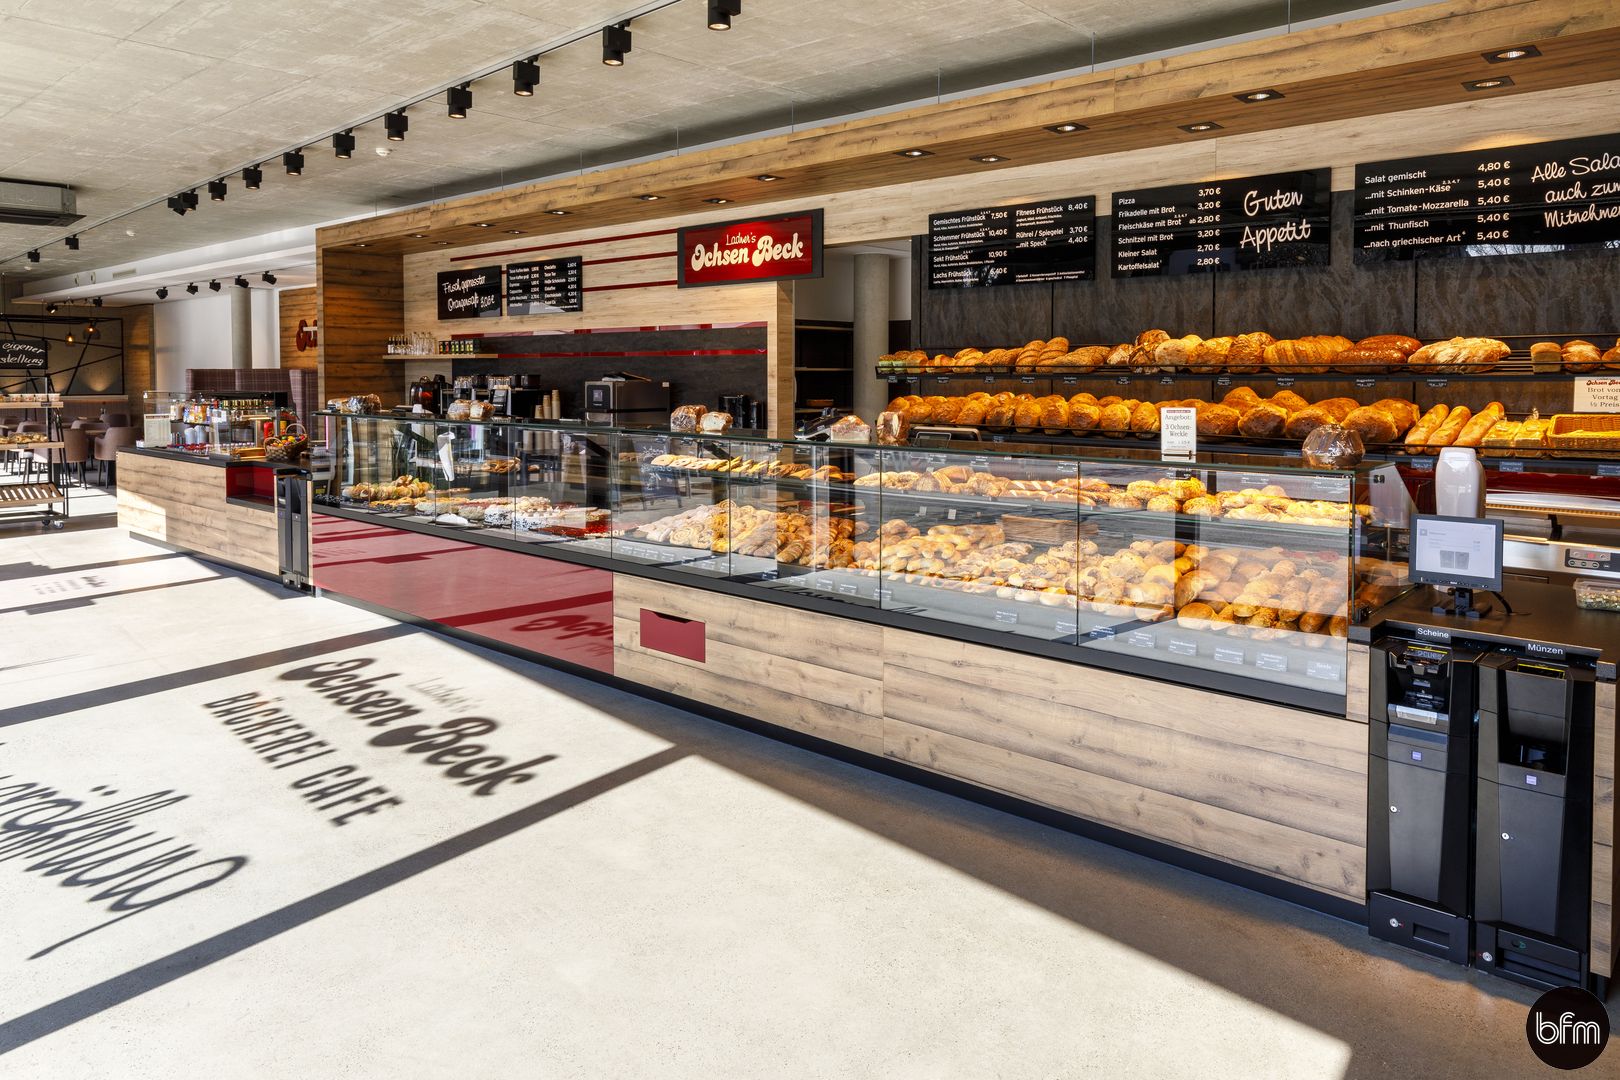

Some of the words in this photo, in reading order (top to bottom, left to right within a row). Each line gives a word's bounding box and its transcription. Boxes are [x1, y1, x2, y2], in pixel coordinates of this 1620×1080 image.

[1365, 174, 1386, 184] Salat
[1388, 170, 1426, 182] gemischt
[1478, 162, 1501, 172] 4,80
[1531, 163, 1567, 183] Alle
[1199, 188, 1214, 197] 3,70
[1387, 184, 1451, 197] Schinken-Käse
[1478, 180, 1500, 189] 5,40
[1545, 181, 1587, 204] auch
[1036, 206, 1064, 214] Frühstück
[1119, 209, 1147, 218] Frikadelle
[1161, 206, 1175, 214] Brot
[1198, 202, 1213, 210] 3,20
[1244, 190, 1303, 216] Guten
[1387, 199, 1469, 214] Tomate-Mozzarella
[1478, 196, 1500, 206] 5,40
[933, 218, 960, 226] Gemischtes
[1118, 222, 1153, 231] Fleischkäse
[1197, 216, 1213, 224] 2,80
[1389, 220, 1429, 230] Thunfisch
[1477, 214, 1500, 223] 5,40
[1544, 203, 1620, 228] Mitnehme
[726, 232, 756, 245] Ladner's
[1038, 228, 1064, 236] Spiegelei
[1118, 236, 1145, 245] Schnitzel
[1197, 230, 1213, 238] 3,20
[1240, 218, 1311, 253] Appetit
[1392, 235, 1444, 247] griechischer
[1446, 233, 1461, 242] Art
[1477, 232, 1500, 241] 5,40
[691, 242, 750, 271] Ochsen
[752, 232, 804, 267] Beck
[1118, 261, 1160, 271] Kartoffelsalat
[1197, 258, 1213, 267] 2,80
[448, 292, 479, 311] Orangensaft
[2, 342, 45, 354] eigener
[1418, 628, 1449, 638] Scheine
[1528, 643, 1563, 655] Münzen
[276, 658, 423, 728] Ochsen
[368, 716, 560, 796] Beck
